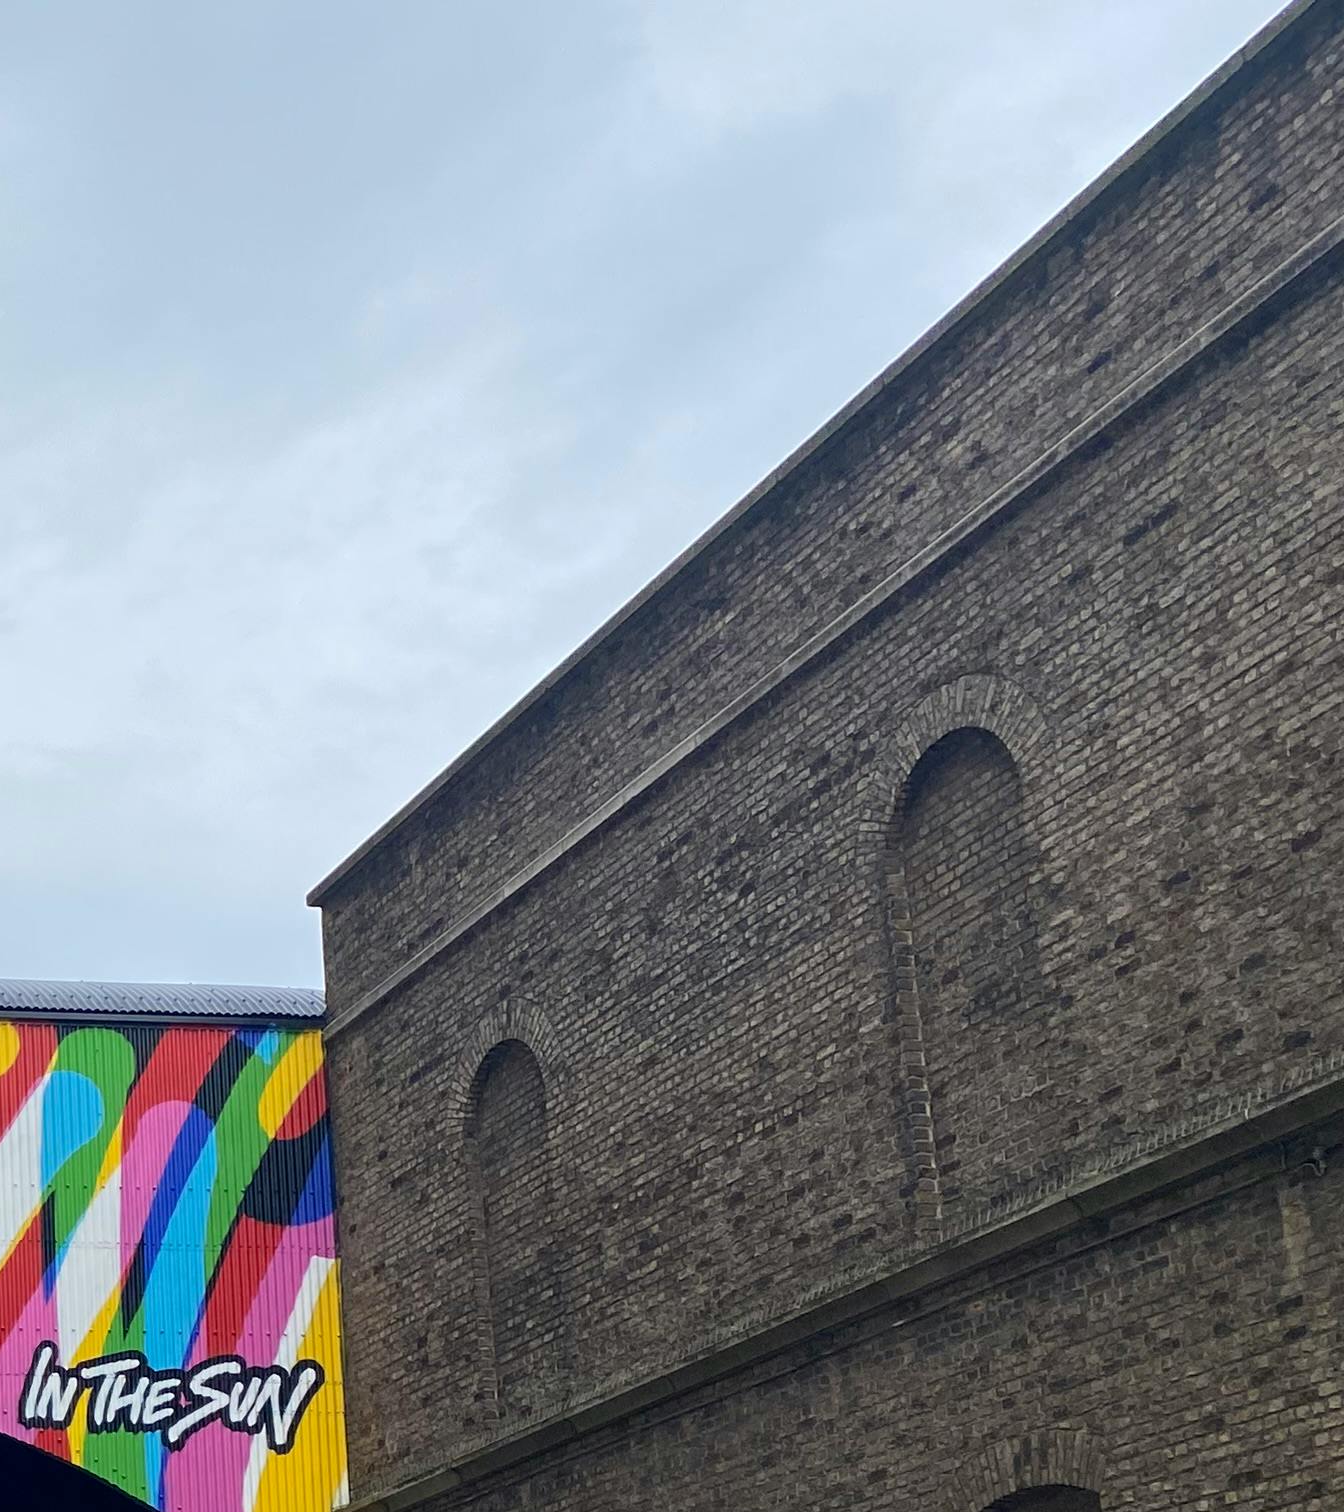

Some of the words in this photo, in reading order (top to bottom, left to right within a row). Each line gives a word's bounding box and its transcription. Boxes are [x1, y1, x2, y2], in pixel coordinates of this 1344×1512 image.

[22, 1344, 78, 1426] IN
[79, 1357, 182, 1429] THE
[168, 1360, 317, 1448] SUN
